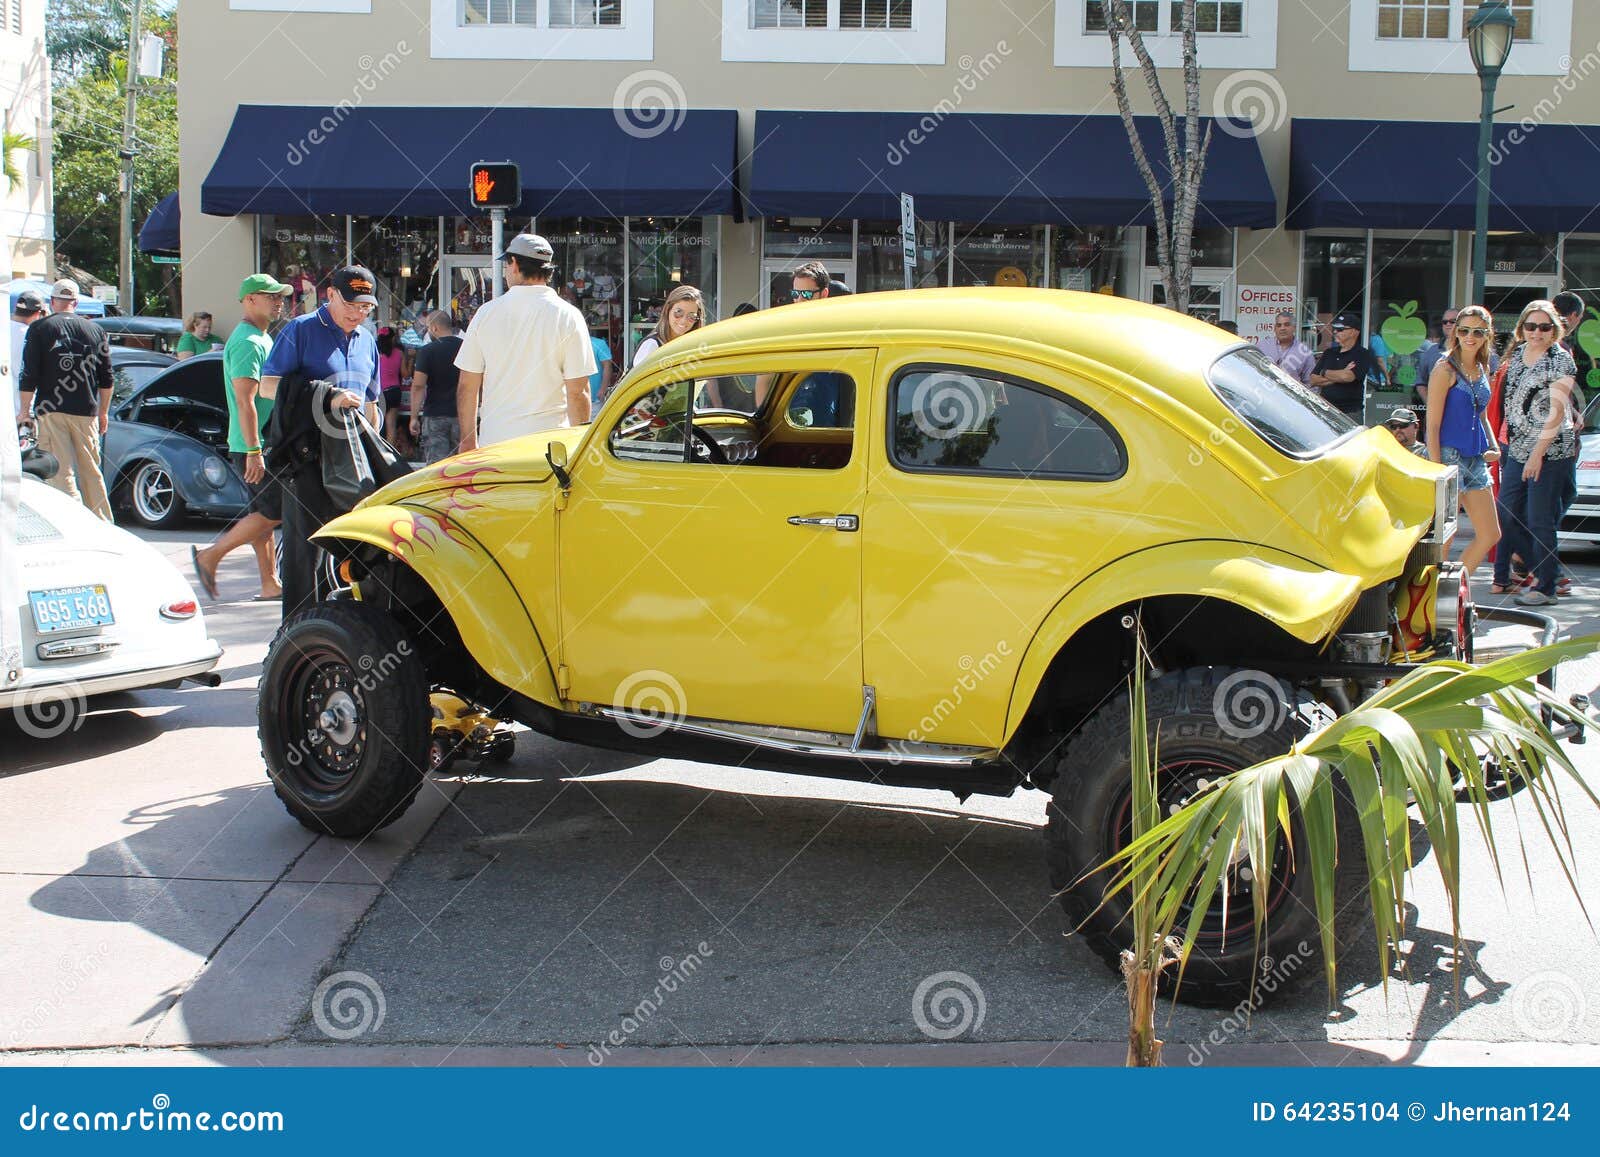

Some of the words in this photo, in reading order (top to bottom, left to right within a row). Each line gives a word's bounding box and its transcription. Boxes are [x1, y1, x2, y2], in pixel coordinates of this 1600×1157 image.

[475, 235, 492, 243] 580
[636, 236, 680, 246] MICHAEL
[683, 236, 711, 246] KORS
[798, 237, 824, 246] 5802
[872, 236, 933, 248] MICLE
[1495, 261, 1515, 271] 5806
[1239, 306, 1259, 315] FOR
[36, 599, 71, 624] BS5
[74, 595, 109, 619] 568
